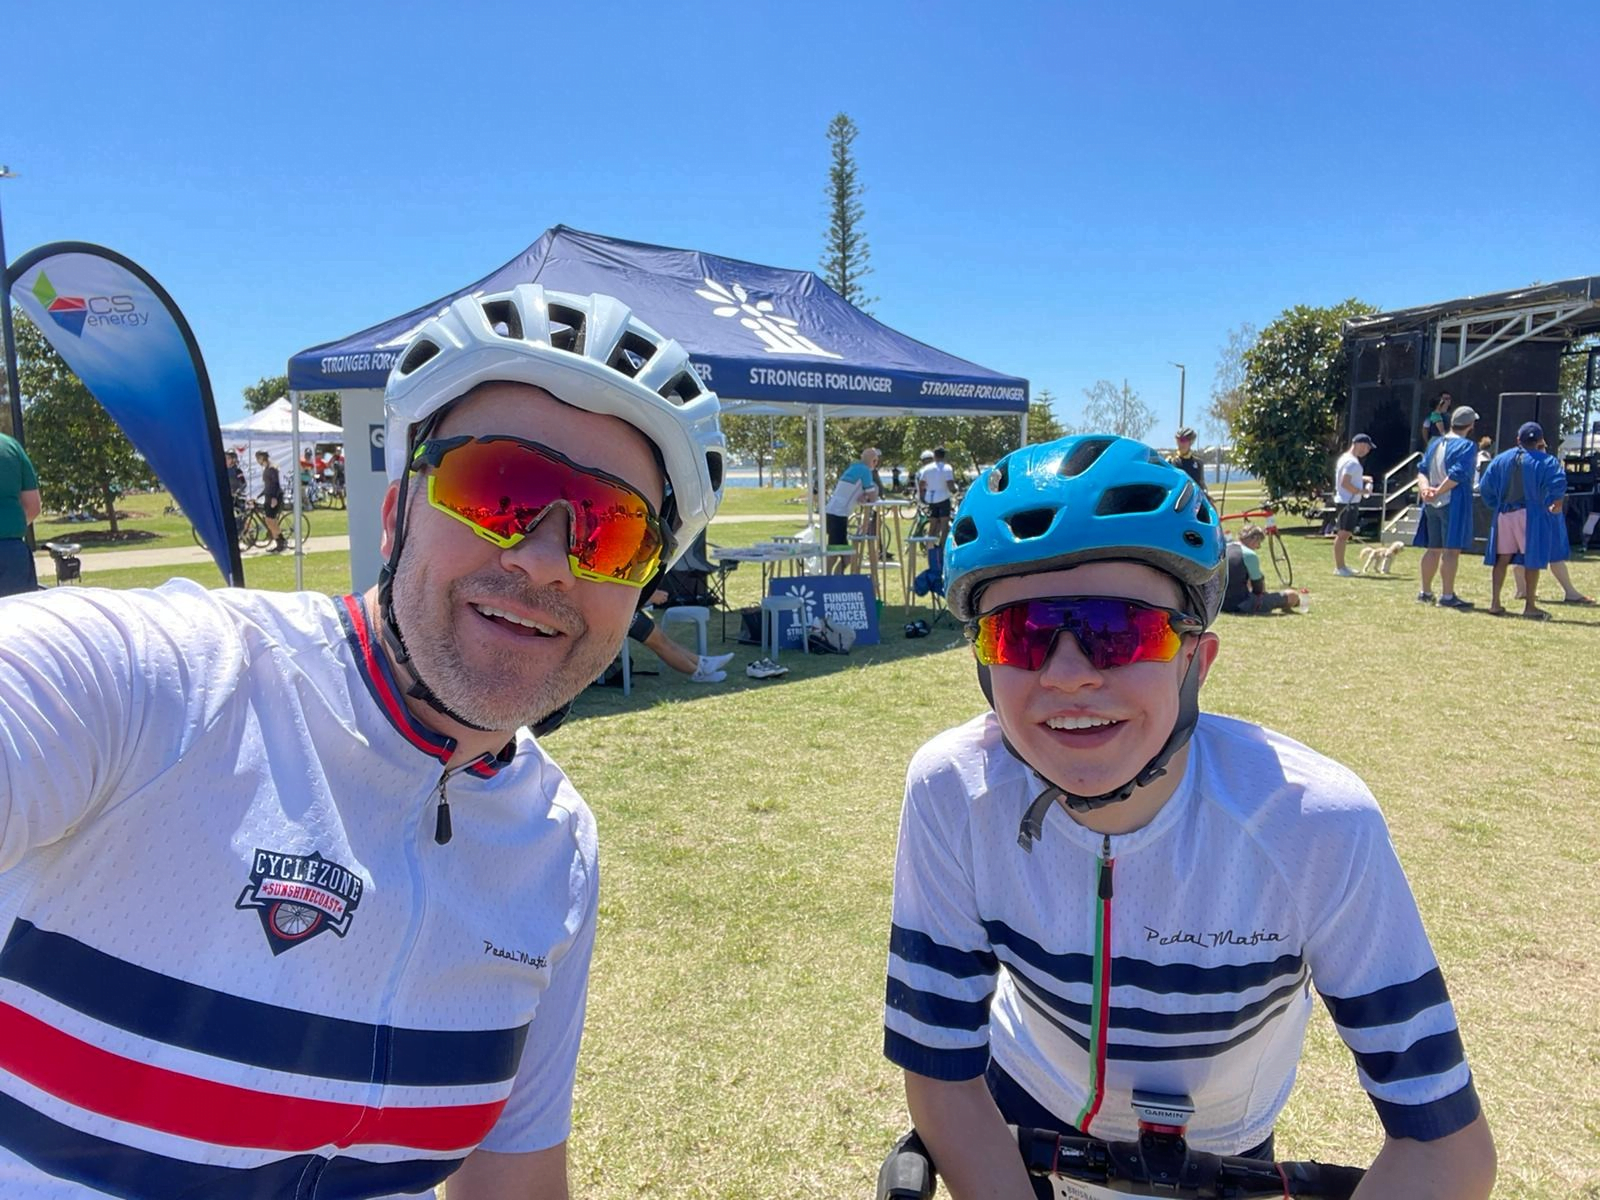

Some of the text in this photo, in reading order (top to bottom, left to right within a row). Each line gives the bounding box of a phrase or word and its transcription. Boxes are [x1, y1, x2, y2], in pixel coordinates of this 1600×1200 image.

[88, 295, 135, 315] CS
[87, 312, 149, 327] energy
[321, 353, 371, 374] STRONGER
[371, 352, 391, 370] FOR
[750, 368, 892, 392] STRONGER FOR LONGER
[920, 381, 1025, 401] STRONGER FOR LONGER
[823, 592, 864, 602] FUNDING
[824, 602, 866, 612] PROSTATE
[1144, 926, 1290, 948] Pedal Mafia
[483, 940, 519, 961] Pedal
[1144, 1109, 1183, 1118] GARMIN
